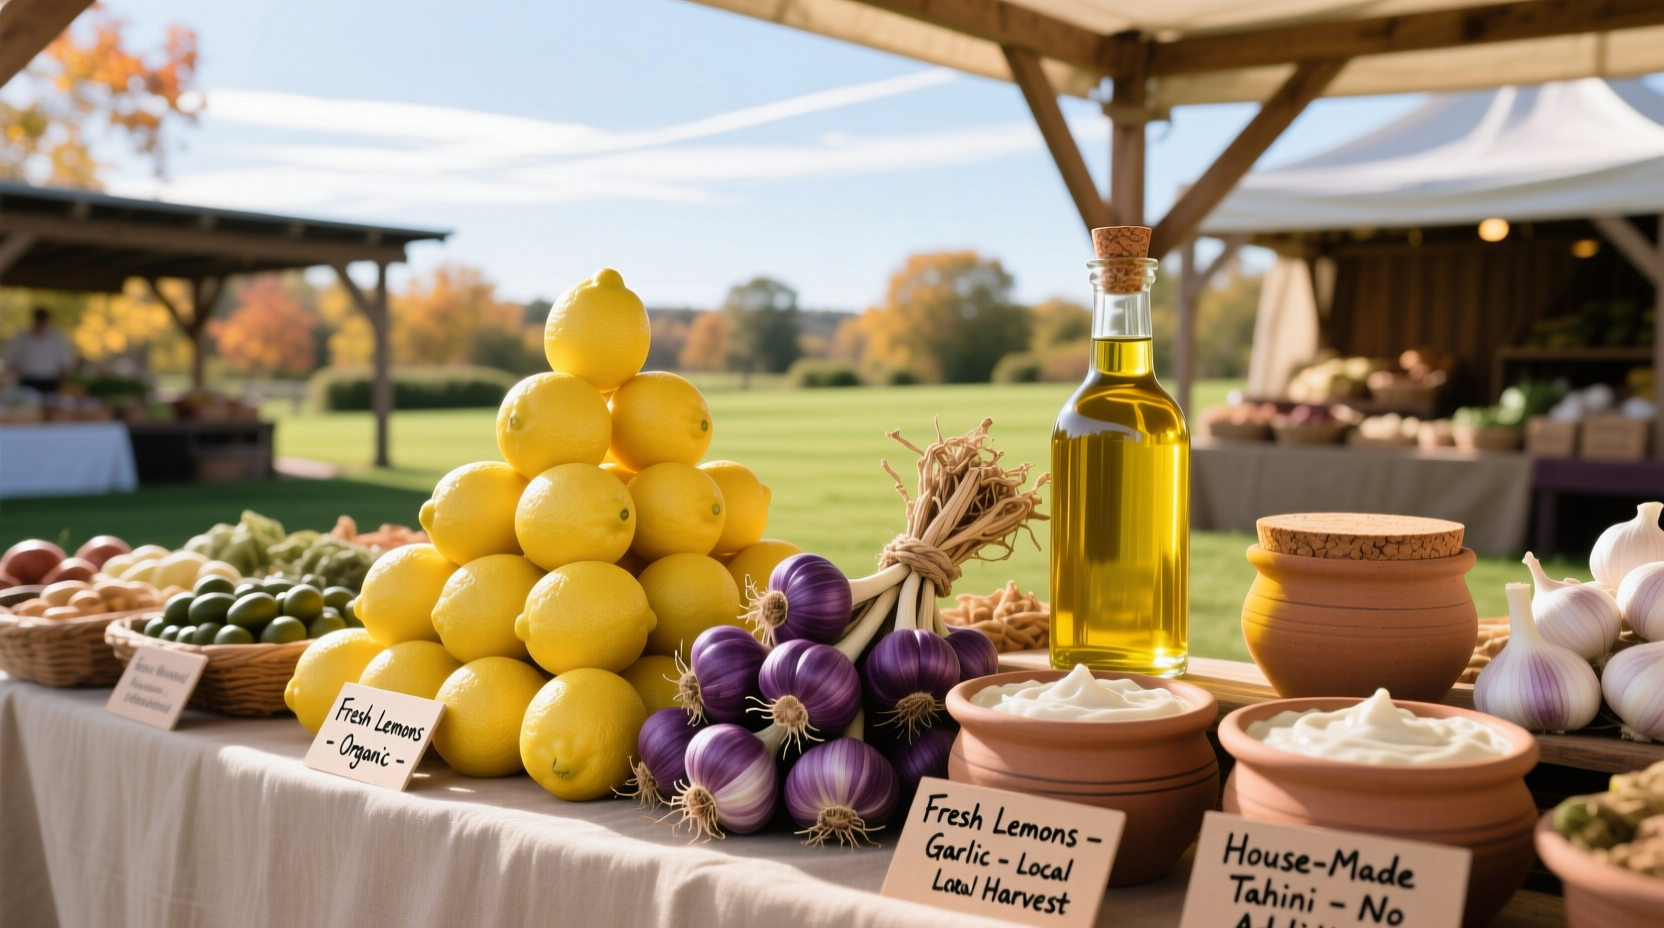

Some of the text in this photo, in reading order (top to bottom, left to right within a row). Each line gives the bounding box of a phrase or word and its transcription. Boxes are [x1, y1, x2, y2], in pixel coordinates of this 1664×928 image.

[335, 697, 425, 742] Fresh Lemons
[339, 733, 391, 770] Organic
[923, 793, 983, 831] Fresh
[992, 806, 1079, 848] Lemons
[925, 832, 991, 867] Garlic
[1016, 852, 1074, 882] Local
[1223, 832, 1416, 890] House-Made
[981, 876, 1071, 915] Harvest
[1230, 874, 1317, 914] Tahini
[1357, 894, 1405, 927] No
